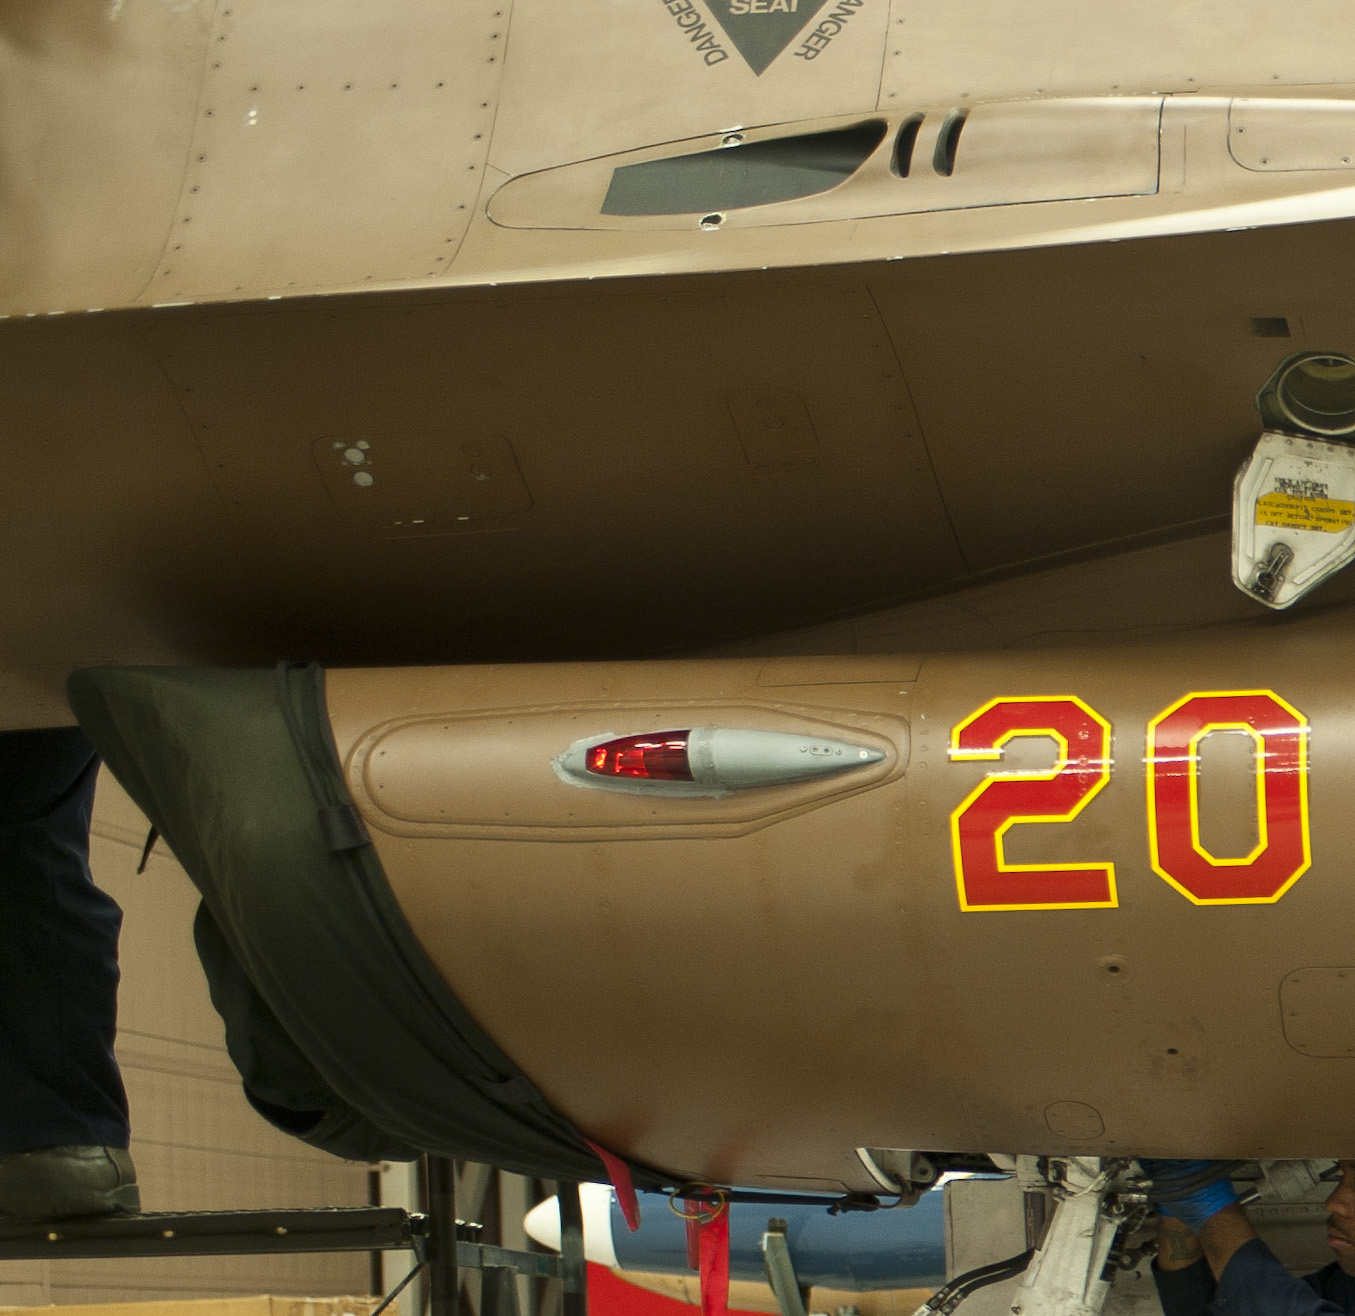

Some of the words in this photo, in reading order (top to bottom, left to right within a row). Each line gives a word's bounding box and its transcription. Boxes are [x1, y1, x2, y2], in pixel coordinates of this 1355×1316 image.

[661, 0, 729, 66] DANGE
[793, 0, 864, 61] ANGER
[950, 689, 1313, 912] 20
